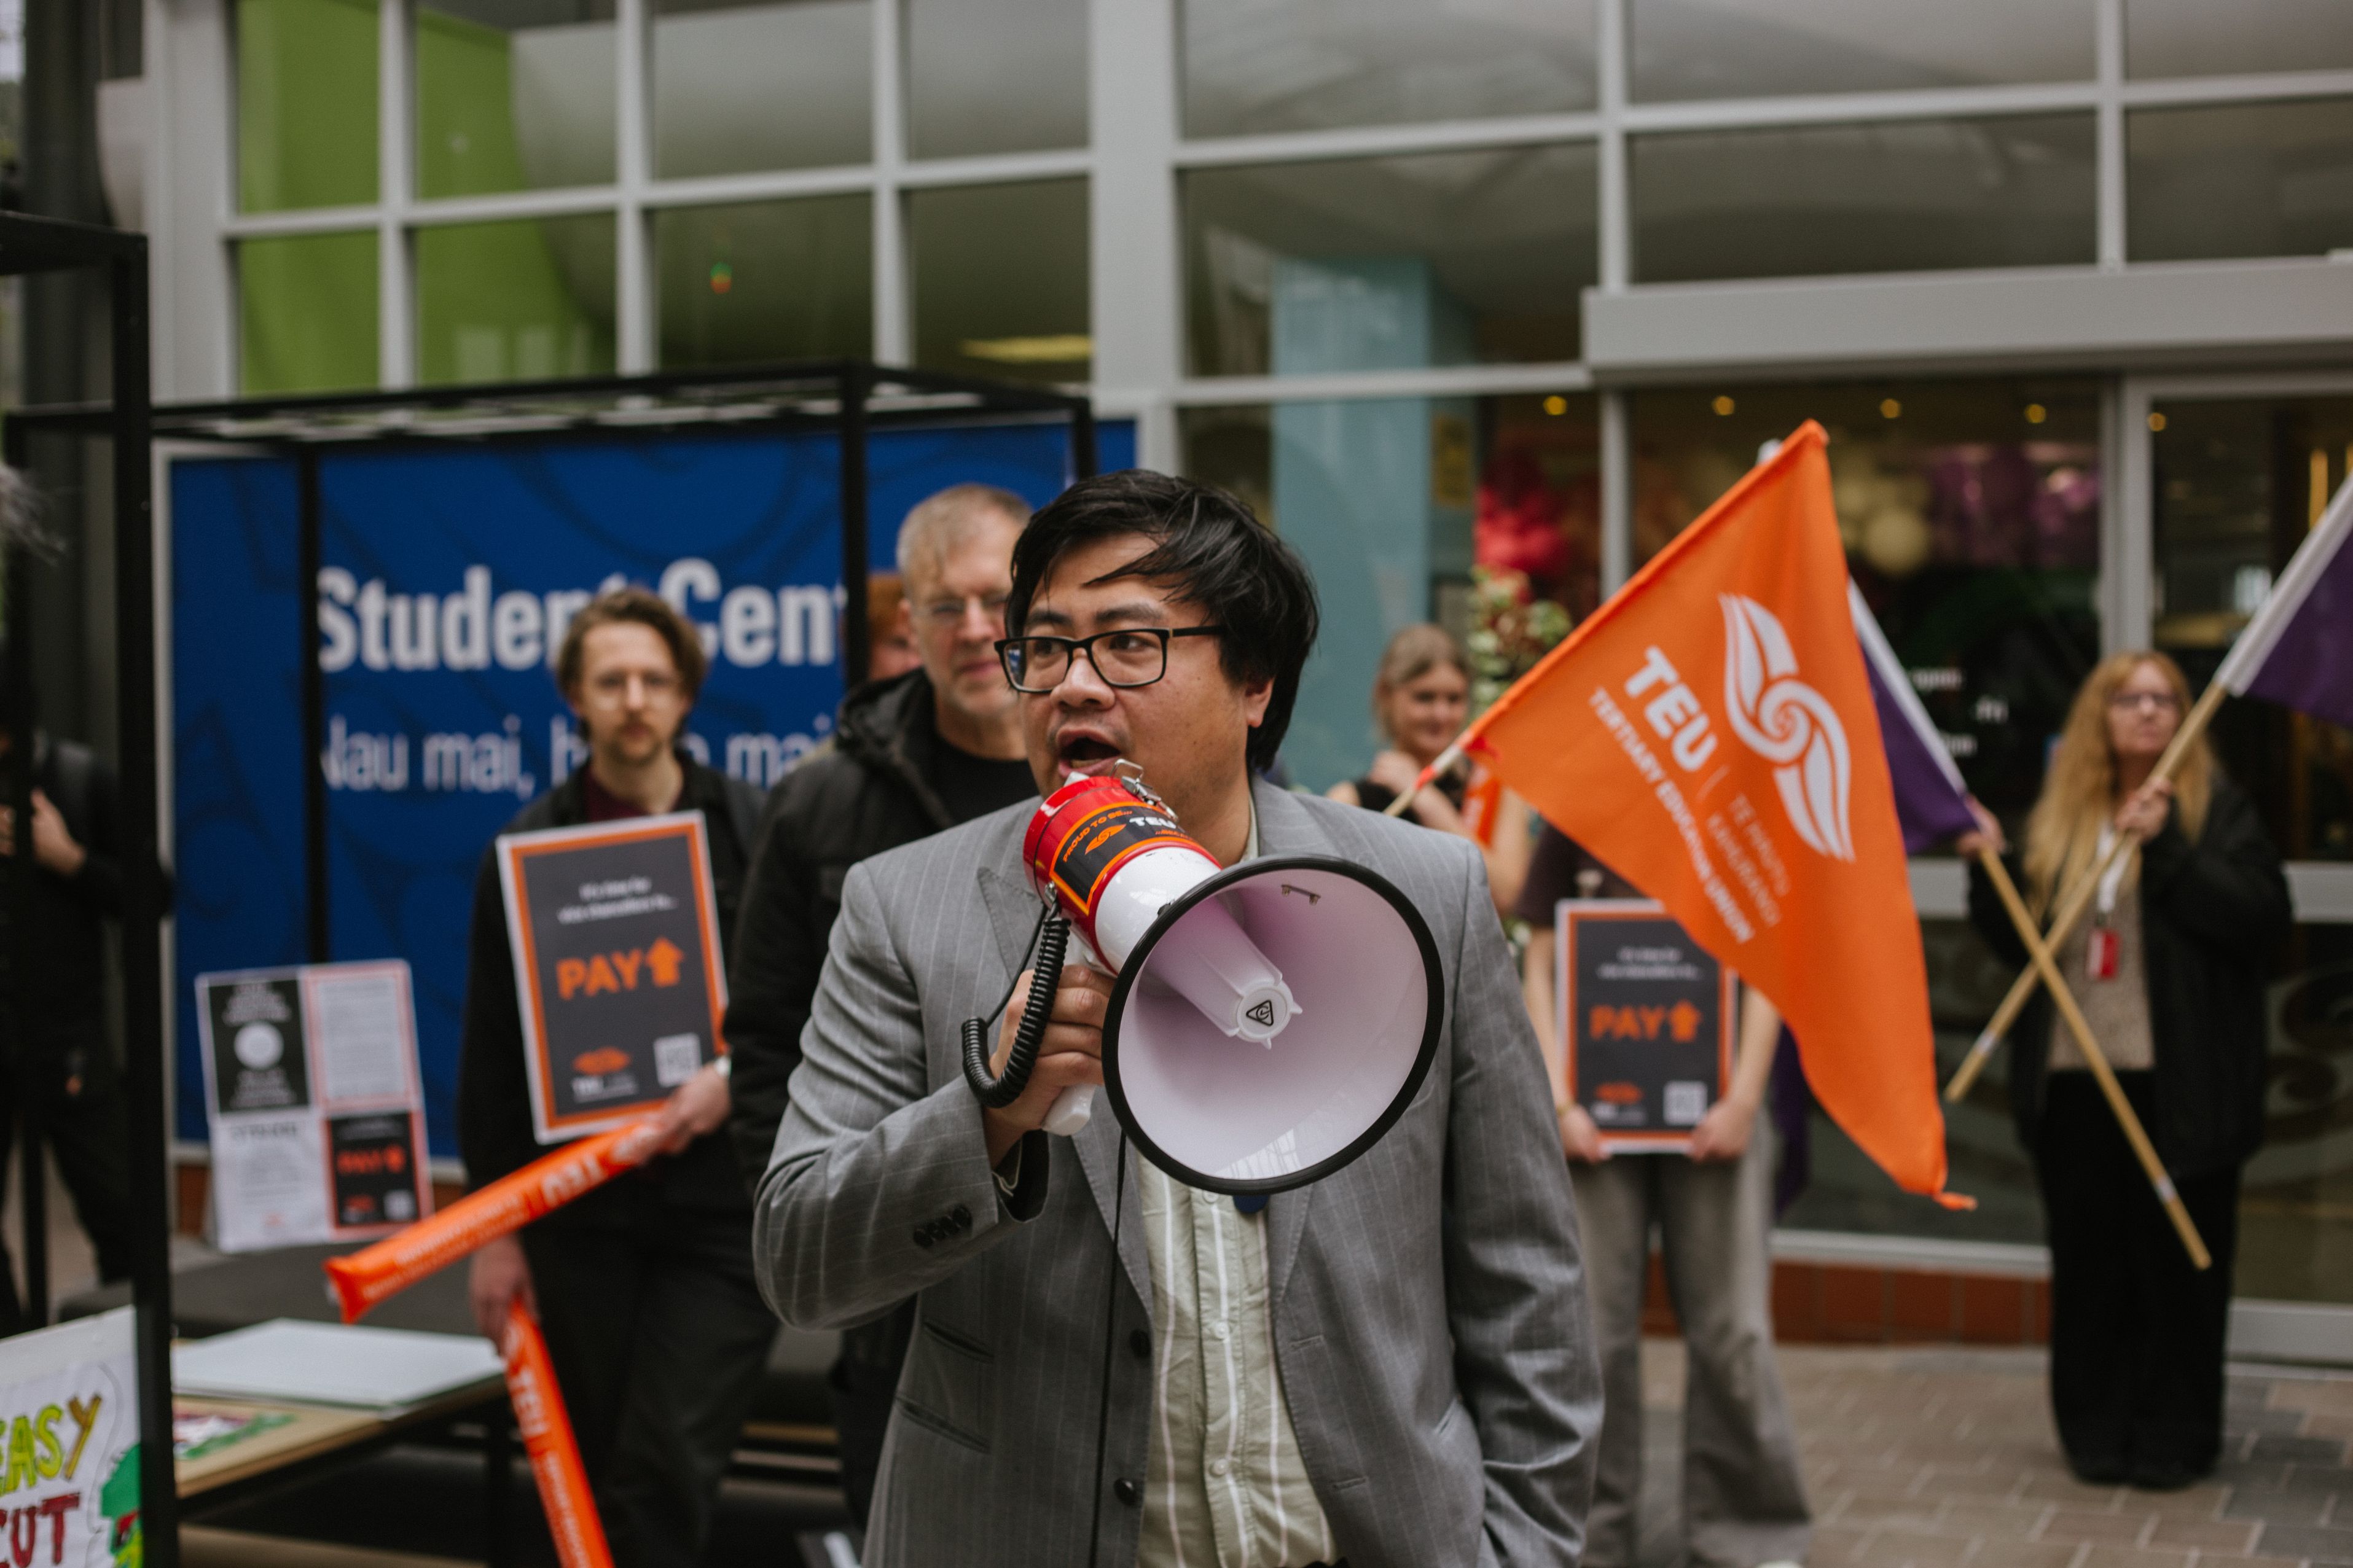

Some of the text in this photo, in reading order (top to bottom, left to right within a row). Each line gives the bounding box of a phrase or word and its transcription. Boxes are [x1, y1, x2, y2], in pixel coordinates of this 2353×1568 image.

[317, 565, 627, 672] Studen
[1589, 686, 1664, 784] TERTIARY
[1624, 645, 1718, 772] TEU
[423, 714, 534, 799] mai,
[1063, 827, 1090, 862] PROUD
[1090, 816, 1106, 828] TO
[1129, 817, 1176, 829] TEU
[556, 948, 643, 1001] PAY
[1589, 1004, 1666, 1042] PAY
